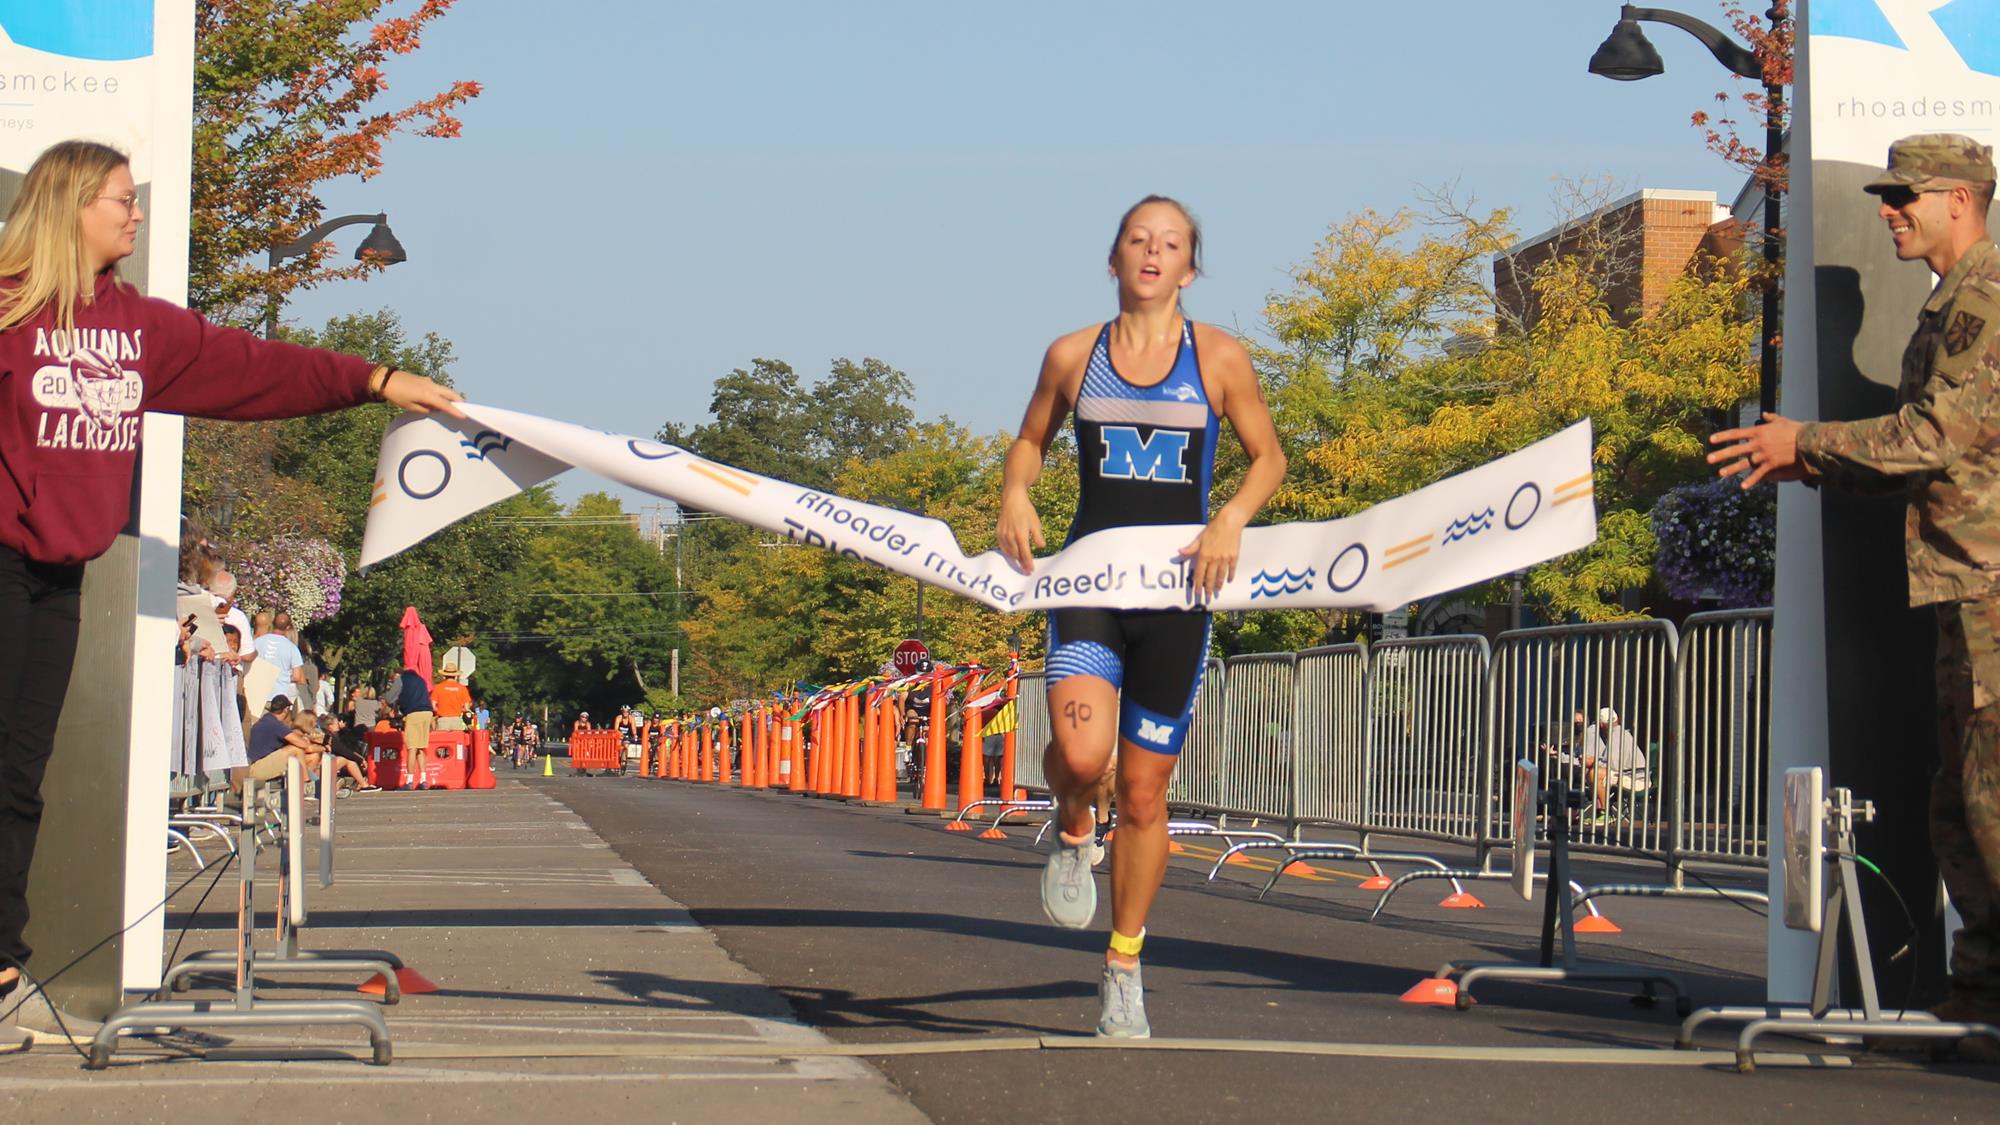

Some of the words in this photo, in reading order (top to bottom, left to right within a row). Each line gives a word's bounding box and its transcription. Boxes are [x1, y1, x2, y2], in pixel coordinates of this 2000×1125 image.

[1837, 97, 2000, 117] rhoadesm
[34, 328, 142, 362] AQUINAS
[42, 376, 67, 395] 20
[125, 381, 138, 399] 15
[37, 412, 140, 451] LACROSSE
[1100, 425, 1190, 483] M
[796, 491, 920, 555] Rhoades
[1034, 563, 1127, 599] Reeds
[895, 651, 928, 665] STOP
[1064, 700, 1092, 730] 90
[1137, 718, 1174, 745] M
